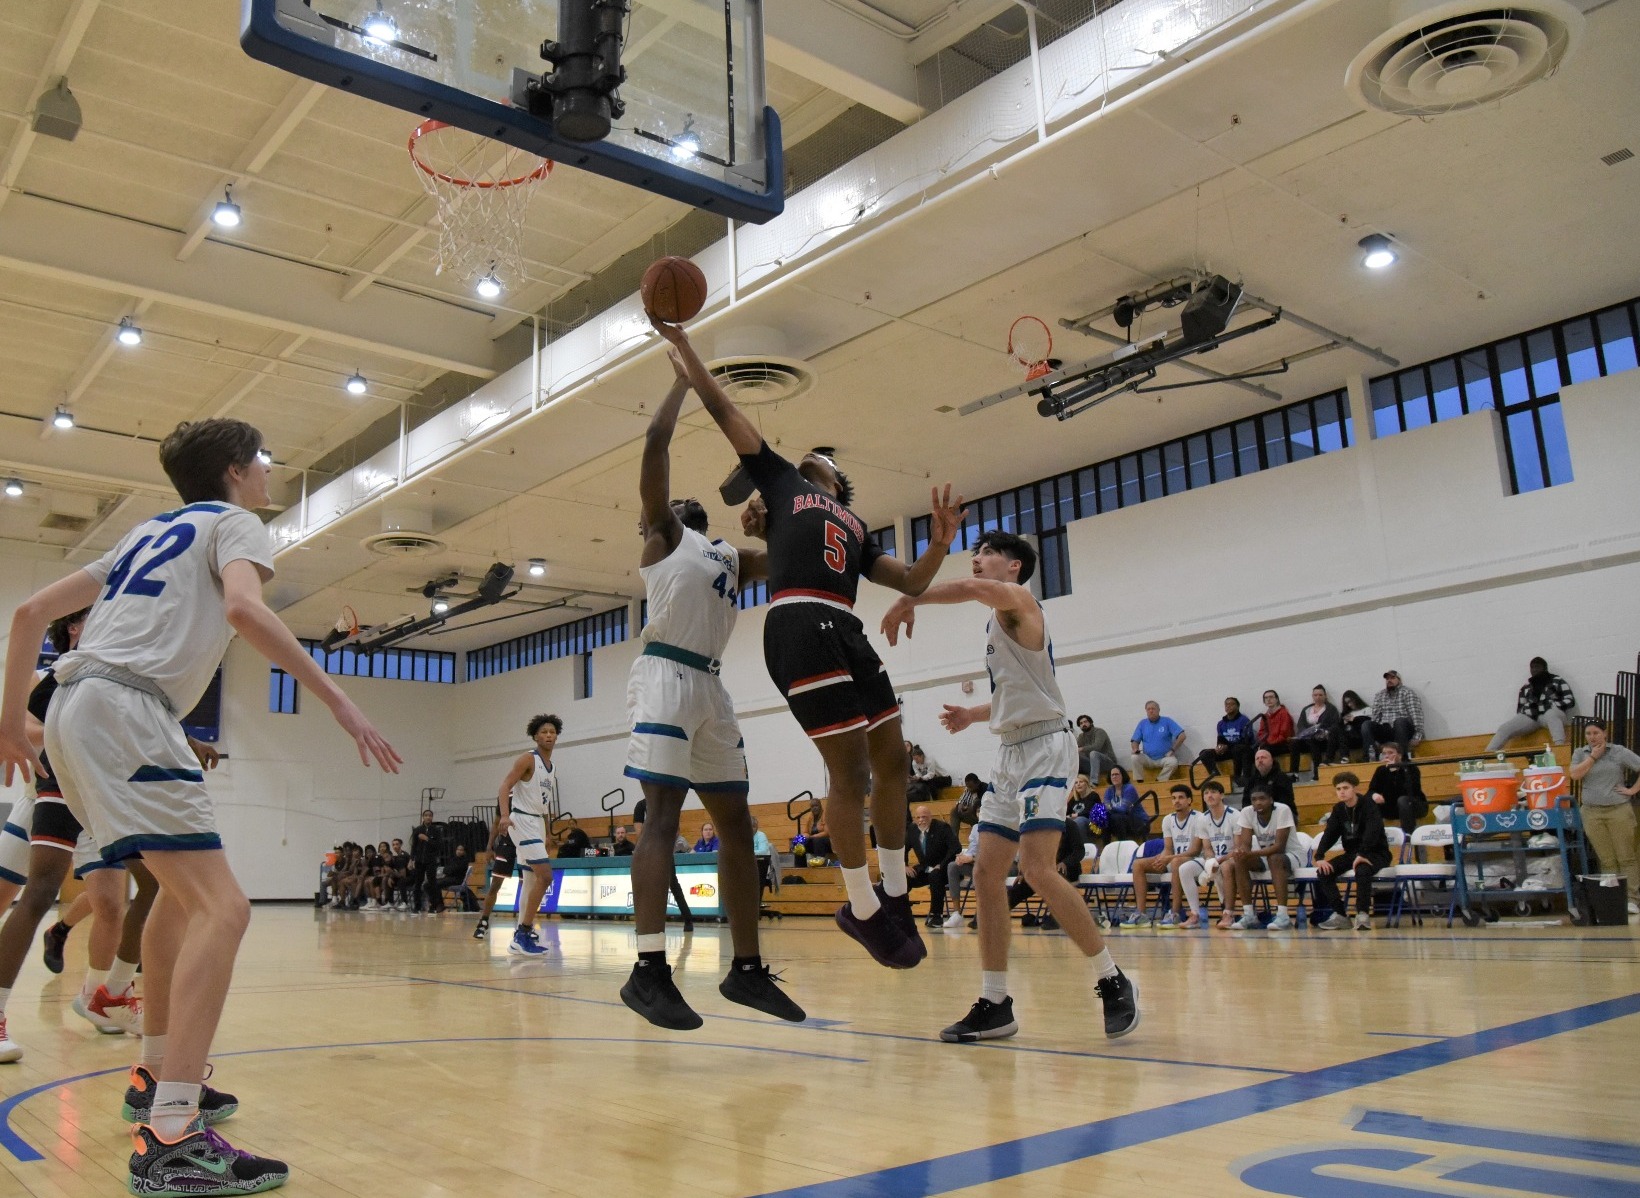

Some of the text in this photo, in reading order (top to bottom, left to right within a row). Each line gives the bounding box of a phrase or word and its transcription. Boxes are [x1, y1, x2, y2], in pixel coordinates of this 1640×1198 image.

[824, 520, 847, 573] 5
[103, 523, 196, 600] 42
[712, 571, 737, 607] 44
[1473, 789, 1485, 802] G
[1215, 843, 1228, 855] 12
[167, 1184, 194, 1193] HUSTLE
